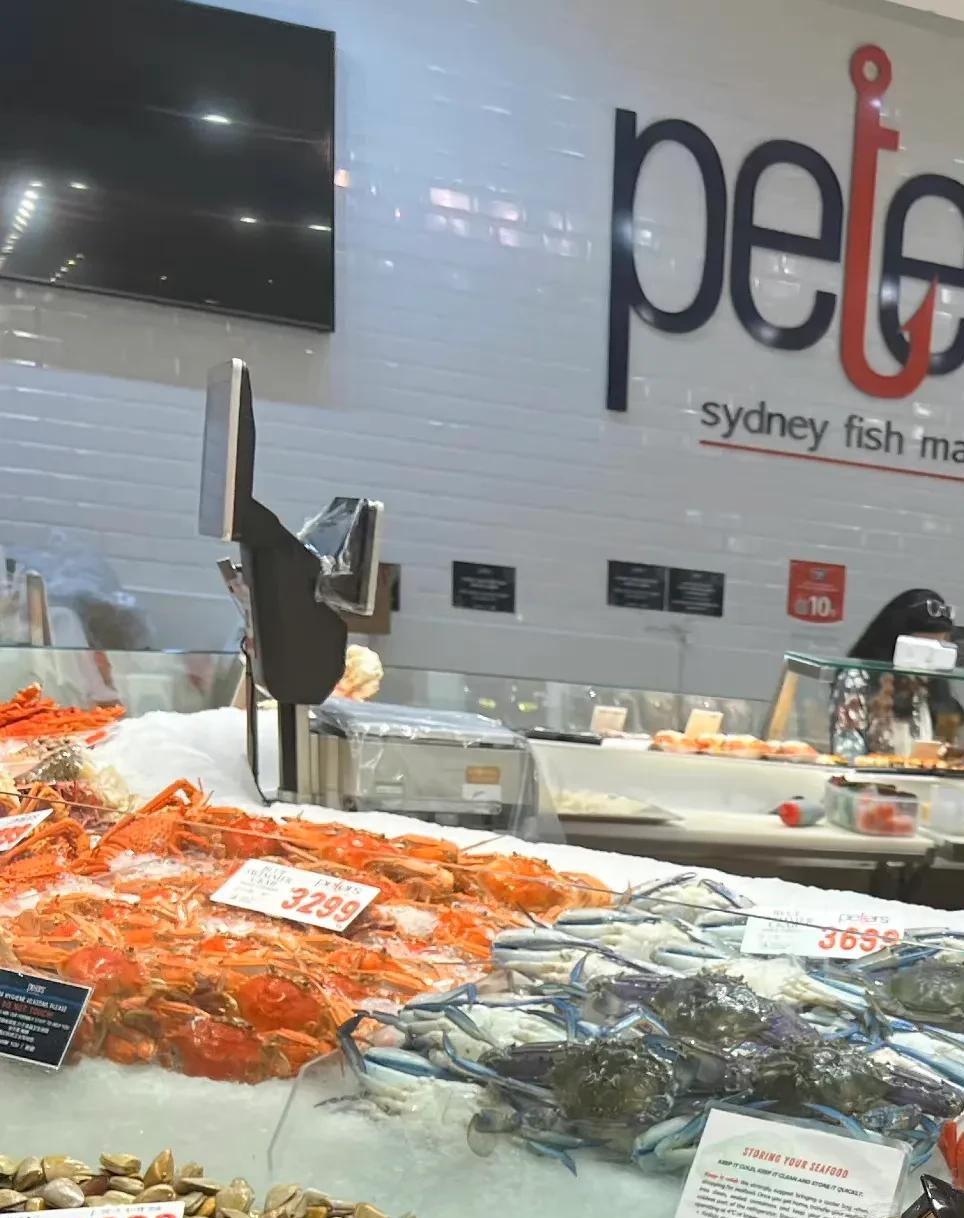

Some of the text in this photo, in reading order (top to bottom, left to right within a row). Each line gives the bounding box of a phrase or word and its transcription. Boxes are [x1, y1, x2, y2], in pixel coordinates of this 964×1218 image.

[701, 401, 829, 451] sydney
[844, 415, 904, 455] fish
[281, 887, 361, 922] 3299
[818, 927, 900, 952] 3699
[742, 1147, 848, 1178] STORING YOUR SEAFOOD
